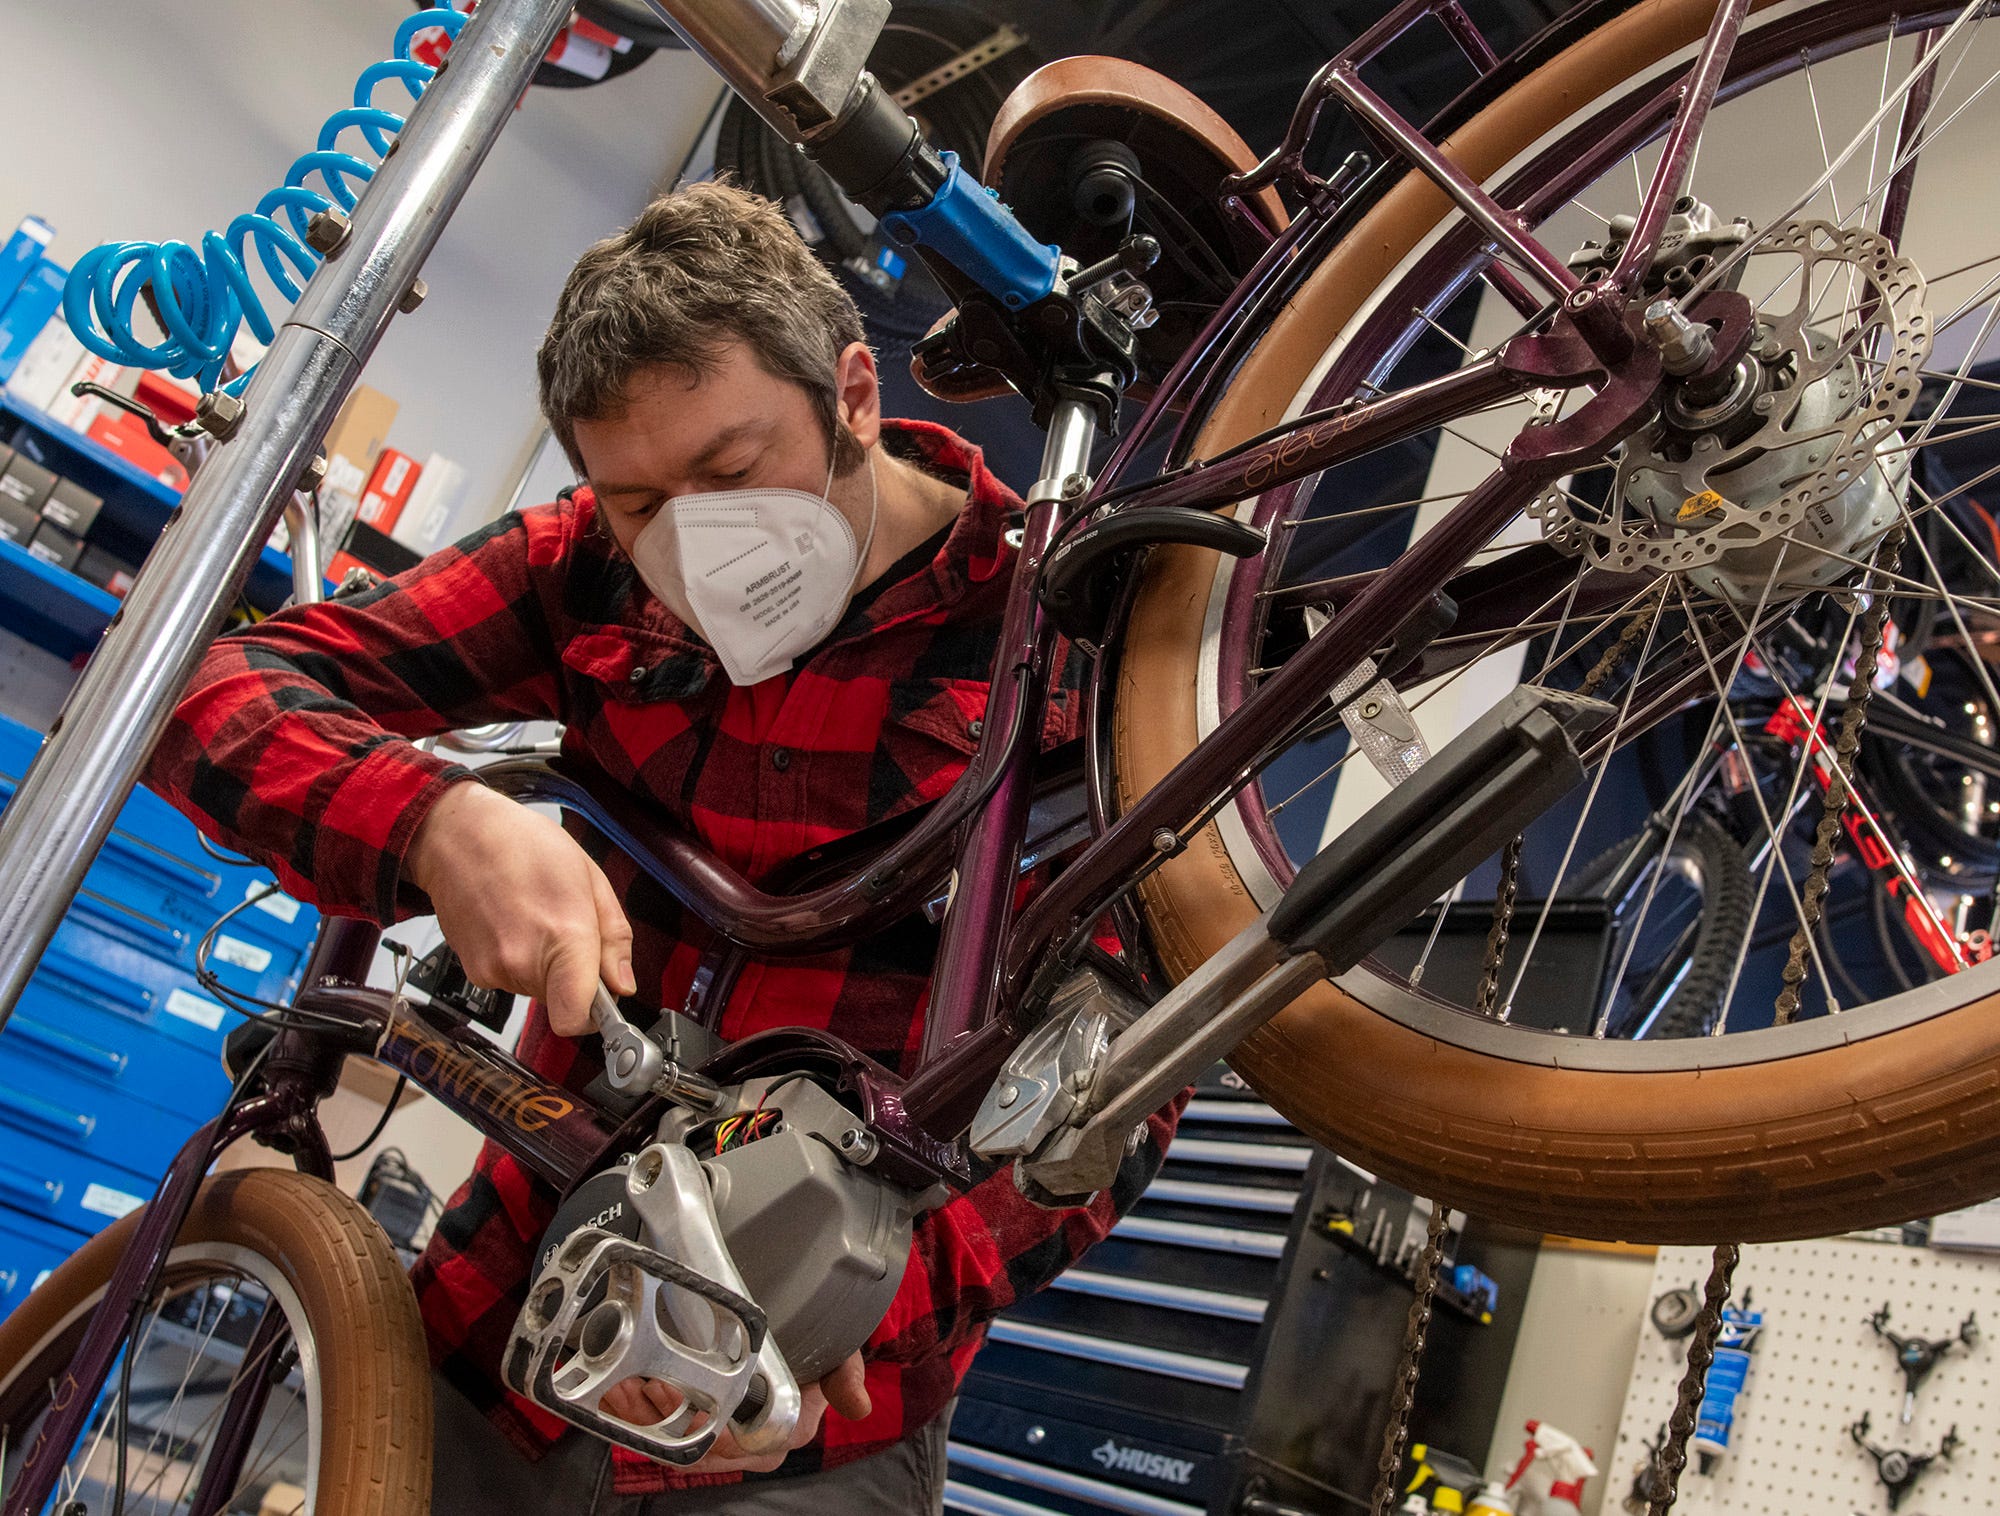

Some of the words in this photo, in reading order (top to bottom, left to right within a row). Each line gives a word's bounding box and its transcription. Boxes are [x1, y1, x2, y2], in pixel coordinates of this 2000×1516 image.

[746, 561, 791, 595] ARMBRUST
[753, 605, 775, 621] MODEL
[764, 614, 781, 627] MADE
[782, 608, 789, 616] IN
[587, 1203, 622, 1229] SCH
[1116, 1447, 1195, 1485] HUSKY
